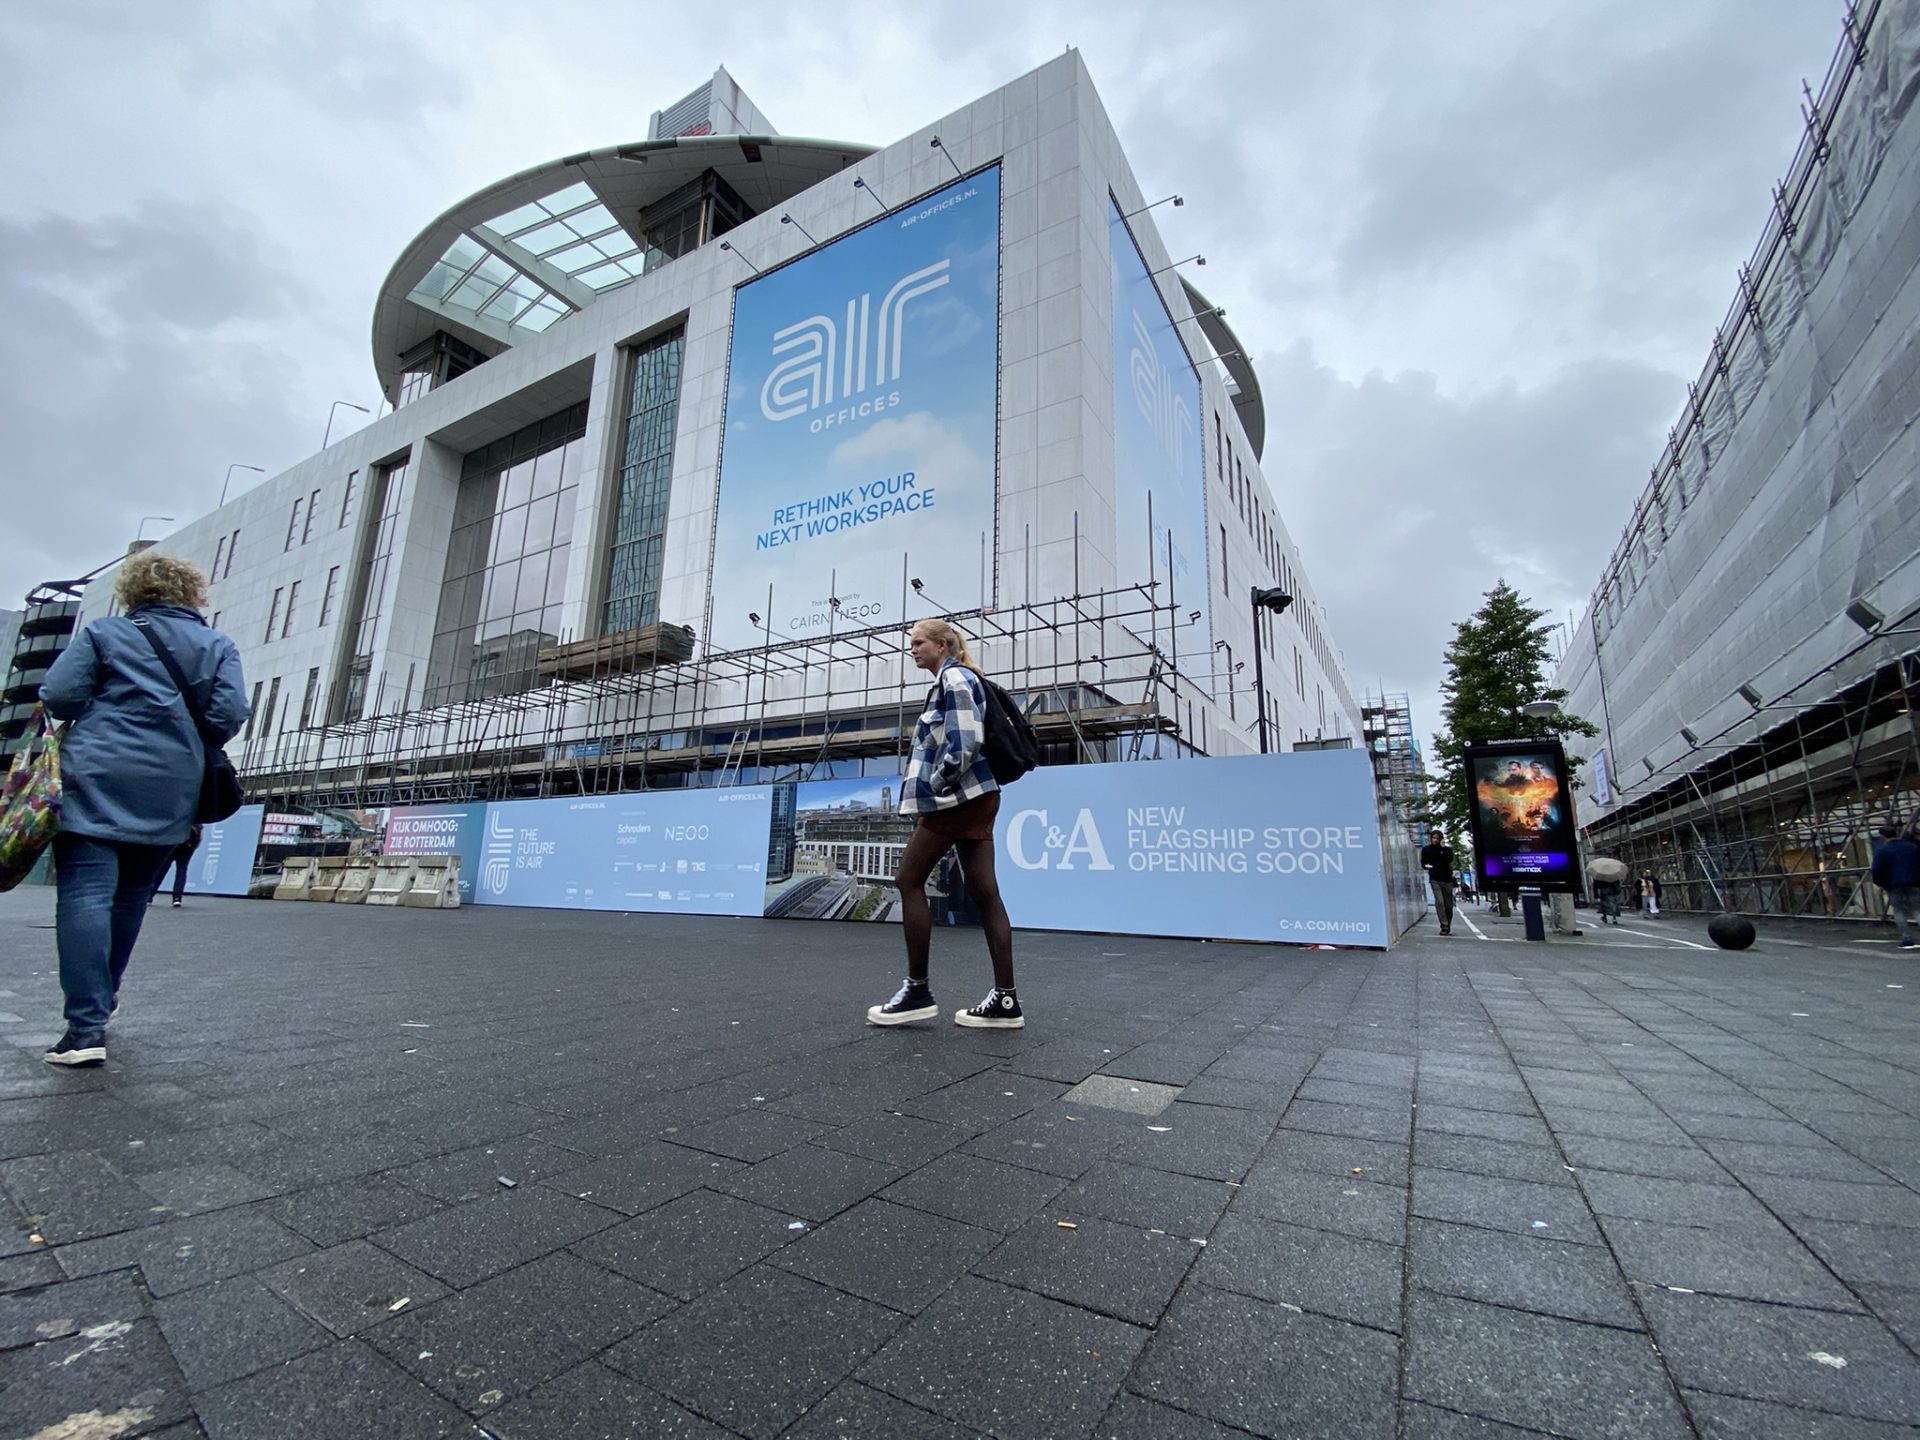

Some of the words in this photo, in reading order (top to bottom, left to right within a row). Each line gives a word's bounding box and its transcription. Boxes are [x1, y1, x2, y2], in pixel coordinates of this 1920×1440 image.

[900, 187, 979, 229] AIR-OFFICES.NL
[810, 391, 901, 433] OFFICES
[773, 488, 854, 526] RETHINK
[858, 471, 916, 502] YOUR
[756, 523, 804, 551] NEXT
[807, 488, 936, 537] WORKSPACE
[789, 612, 831, 630] CAIRN
[392, 821, 412, 833] KIJK
[412, 819, 459, 833] OMHOOG:
[1127, 806, 1185, 827] NEW
[390, 836, 403, 848] ZIE
[403, 835, 456, 848] ROTTERDAM
[520, 828, 539, 840] THE
[664, 824, 710, 841] NEOO
[1006, 807, 1115, 871] C&A
[1128, 828, 1255, 850] FLAGSHIP
[1263, 826, 1364, 849] STORE
[517, 842, 556, 854] FUTURE
[515, 856, 525, 868] IS
[525, 856, 543, 868] AIR
[1128, 851, 1248, 873] OPENING
[1255, 851, 1344, 874] SOON
[1279, 919, 1370, 933] C-A.COM/HOI
